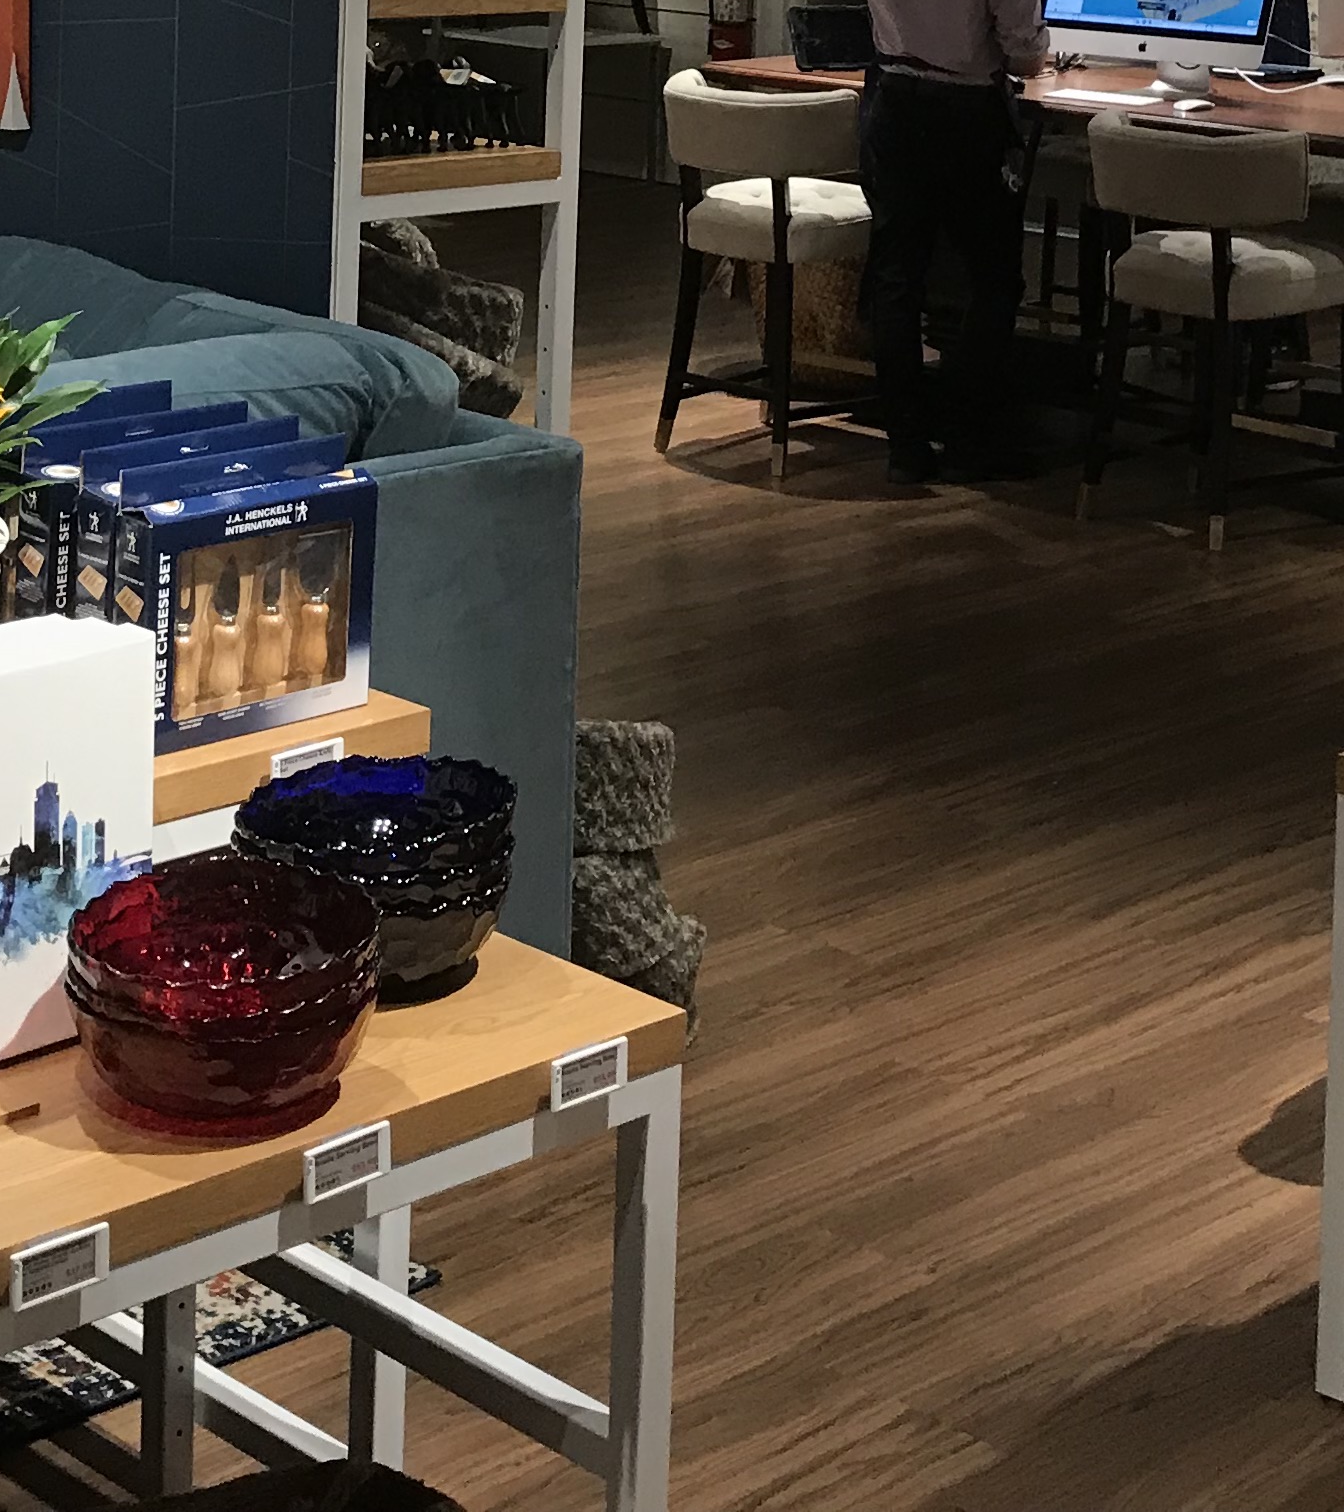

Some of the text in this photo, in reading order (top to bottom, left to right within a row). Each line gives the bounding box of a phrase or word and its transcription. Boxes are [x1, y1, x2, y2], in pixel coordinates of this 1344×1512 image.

[224, 515, 292, 536] INTERNATIONAL
[225, 503, 293, 525] J.A. HENCKELS
[56, 512, 70, 608] CHEESE SET
[159, 553, 171, 585] SET
[157, 588, 170, 655] CHEESE
[155, 659, 167, 707] PIECE
